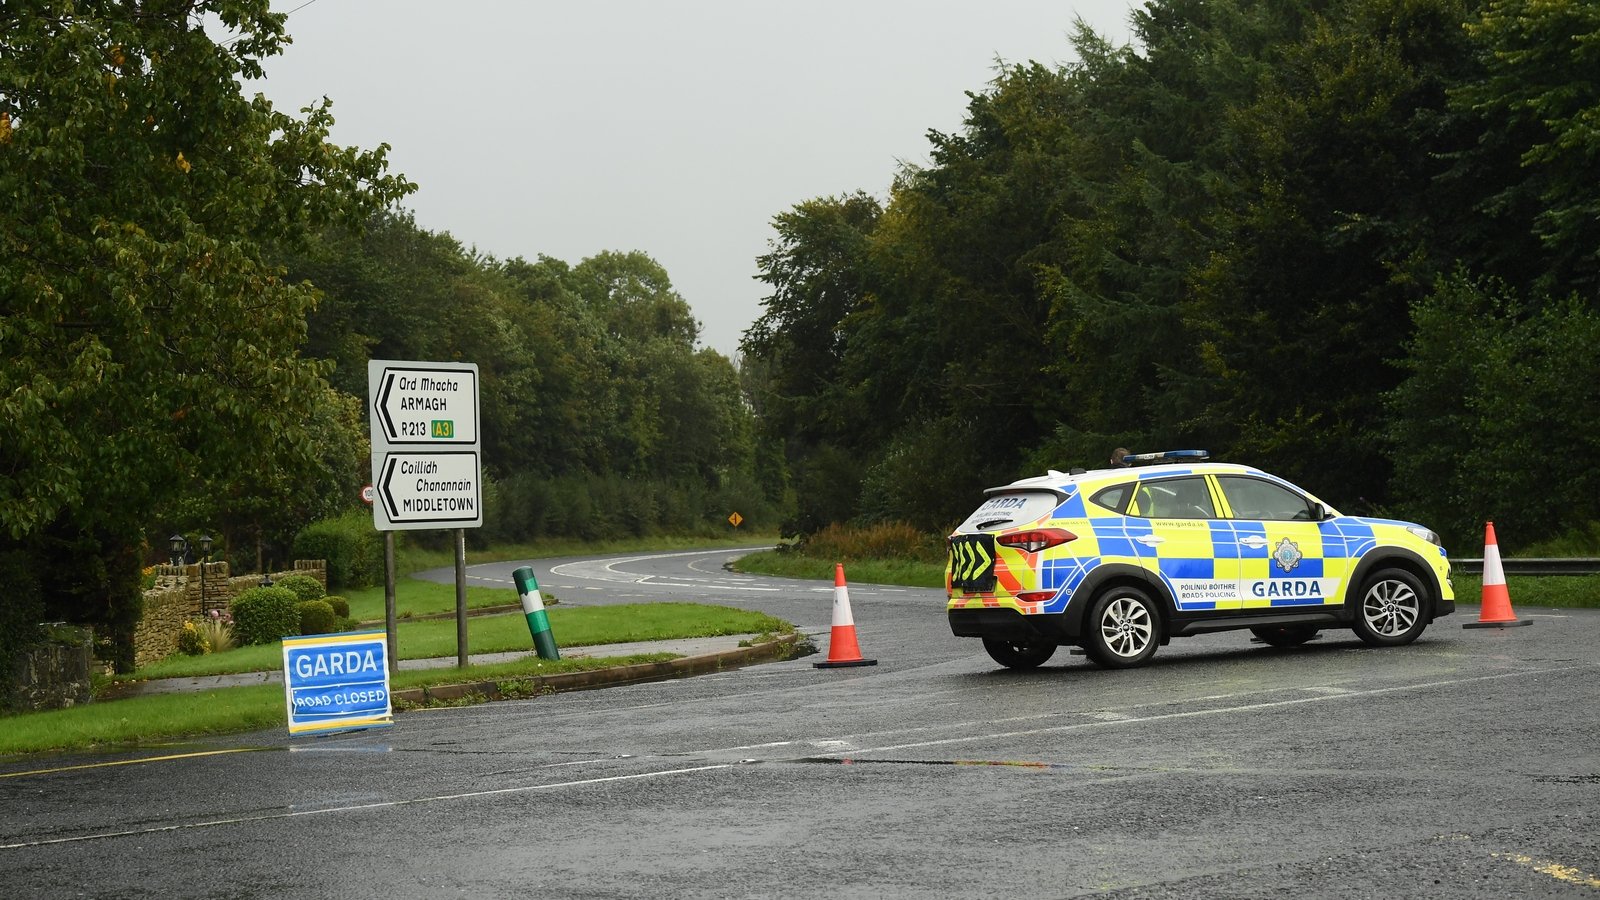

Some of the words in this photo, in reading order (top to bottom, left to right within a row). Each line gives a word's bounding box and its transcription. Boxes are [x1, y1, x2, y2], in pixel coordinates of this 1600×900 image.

[399, 377, 417, 391] Ard
[420, 377, 458, 392] Mhacha
[400, 397, 447, 411] ARMAGH
[401, 421, 426, 436] R213
[401, 460, 438, 475] Coillidh
[403, 497, 474, 512] MIDDLETOWN
[981, 497, 1027, 511] GARDA
[1252, 581, 1322, 597] GARDA
[295, 650, 377, 678] GARDA
[296, 695, 331, 707] ROAD
[334, 690, 385, 706] CLOSED
